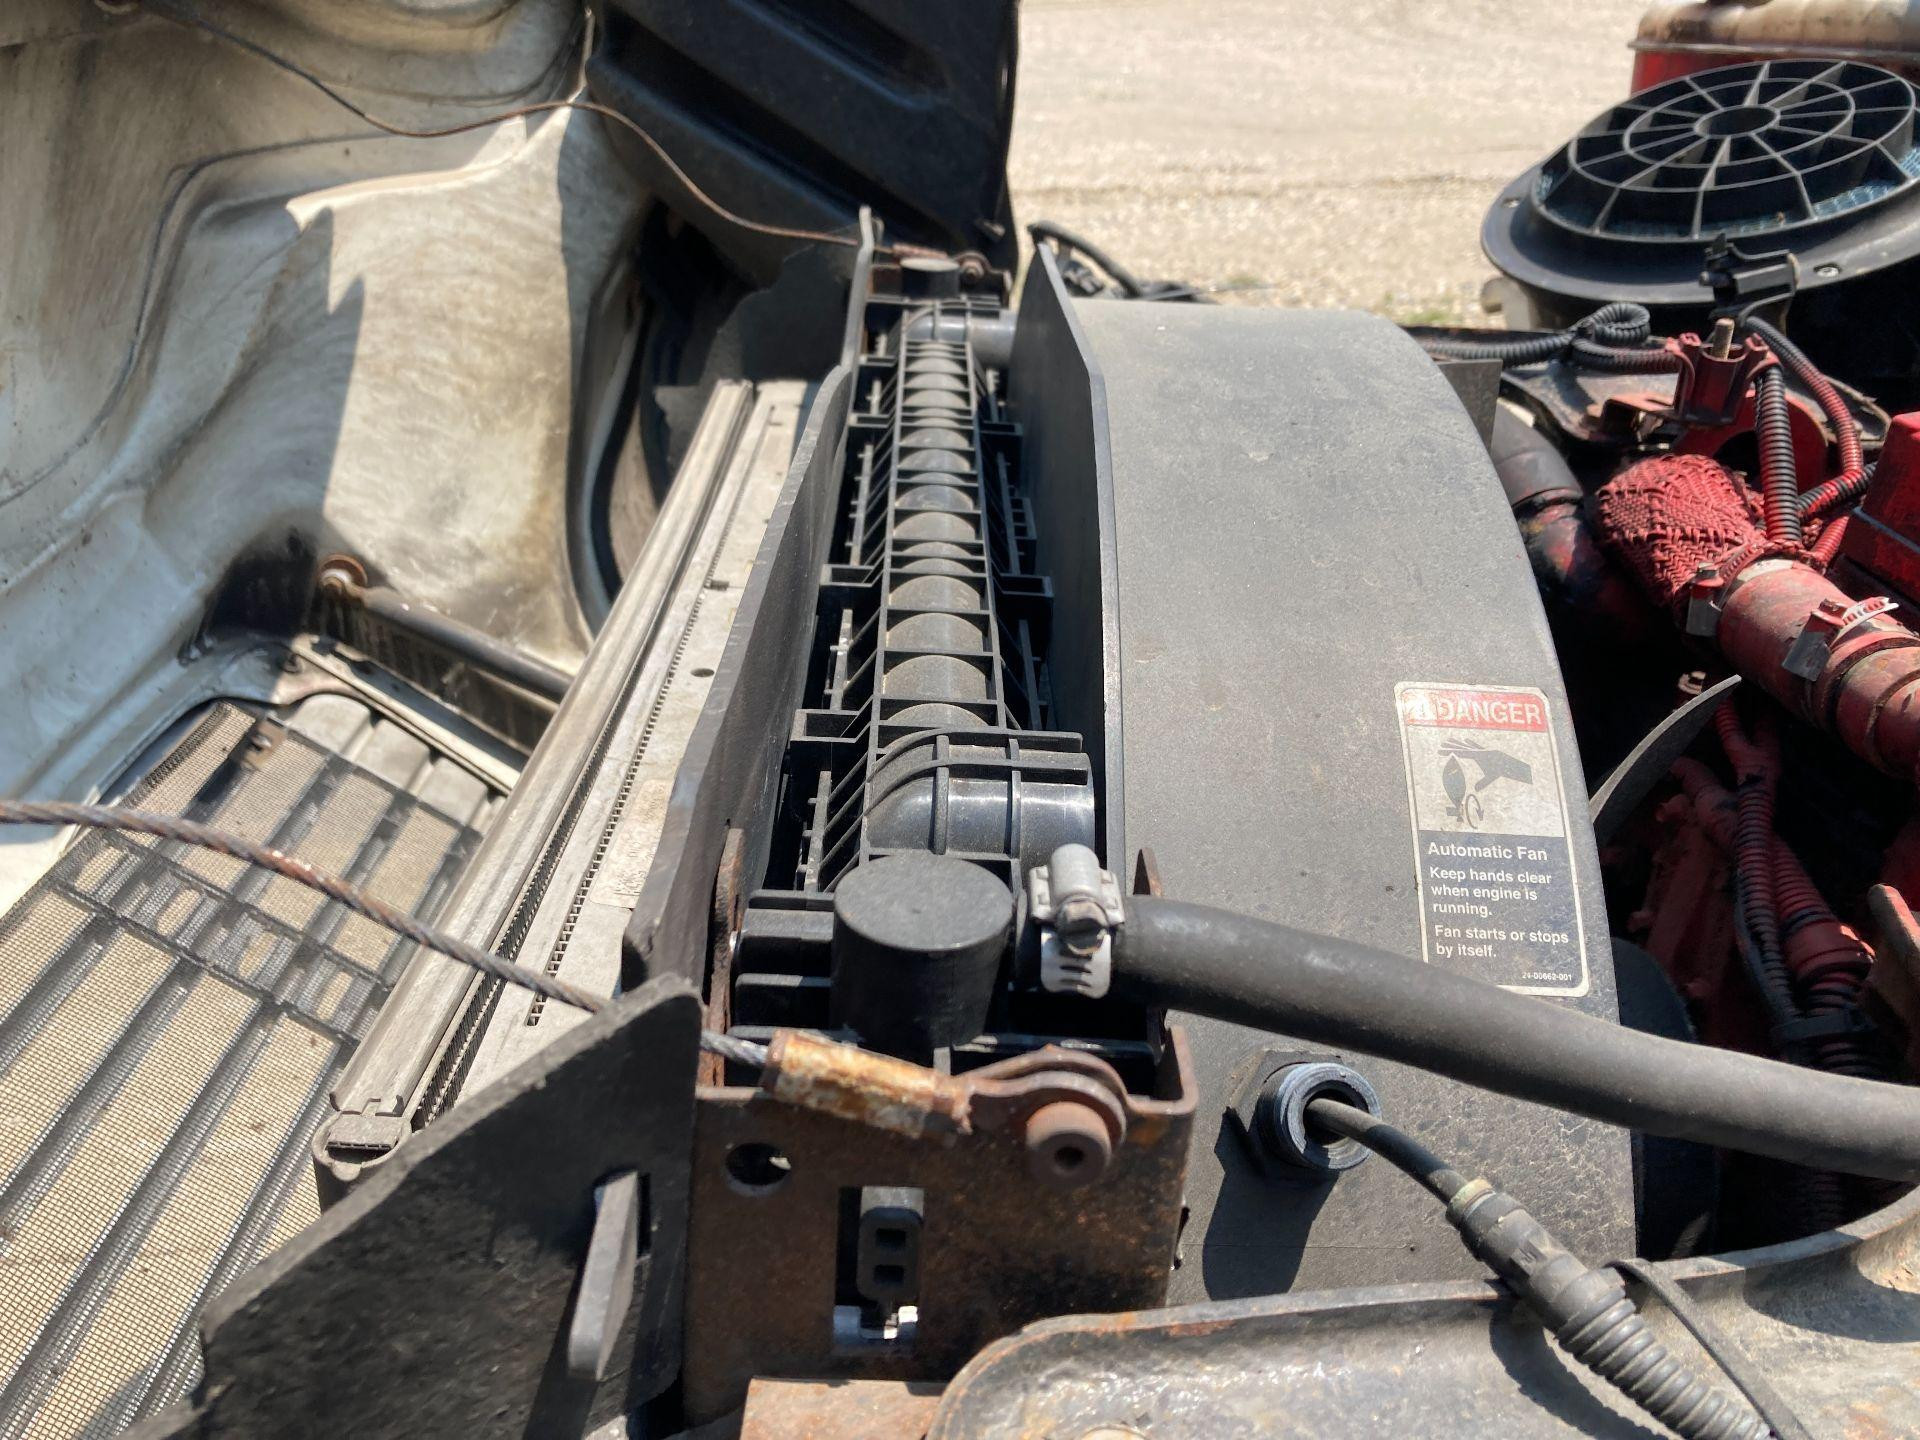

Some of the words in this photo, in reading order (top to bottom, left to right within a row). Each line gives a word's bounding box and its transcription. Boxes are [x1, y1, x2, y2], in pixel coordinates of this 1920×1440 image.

[1436, 698, 1542, 725] DANGER
[1428, 842, 1513, 859] Automatic
[1517, 846, 1548, 860] Fan
[1429, 866, 1466, 882] Keep
[1469, 868, 1514, 882] hands
[1517, 871, 1552, 884] clear
[1431, 884, 1469, 897] when
[1473, 887, 1521, 901] engine
[1525, 887, 1538, 900] is
[1433, 902, 1493, 918] running.
[1434, 924, 1461, 938] Fan
[1465, 927, 1507, 940] starts
[1510, 930, 1525, 941] or
[1529, 930, 1569, 946] stops
[1436, 942, 1453, 958] by
[1457, 943, 1497, 957] itself.
